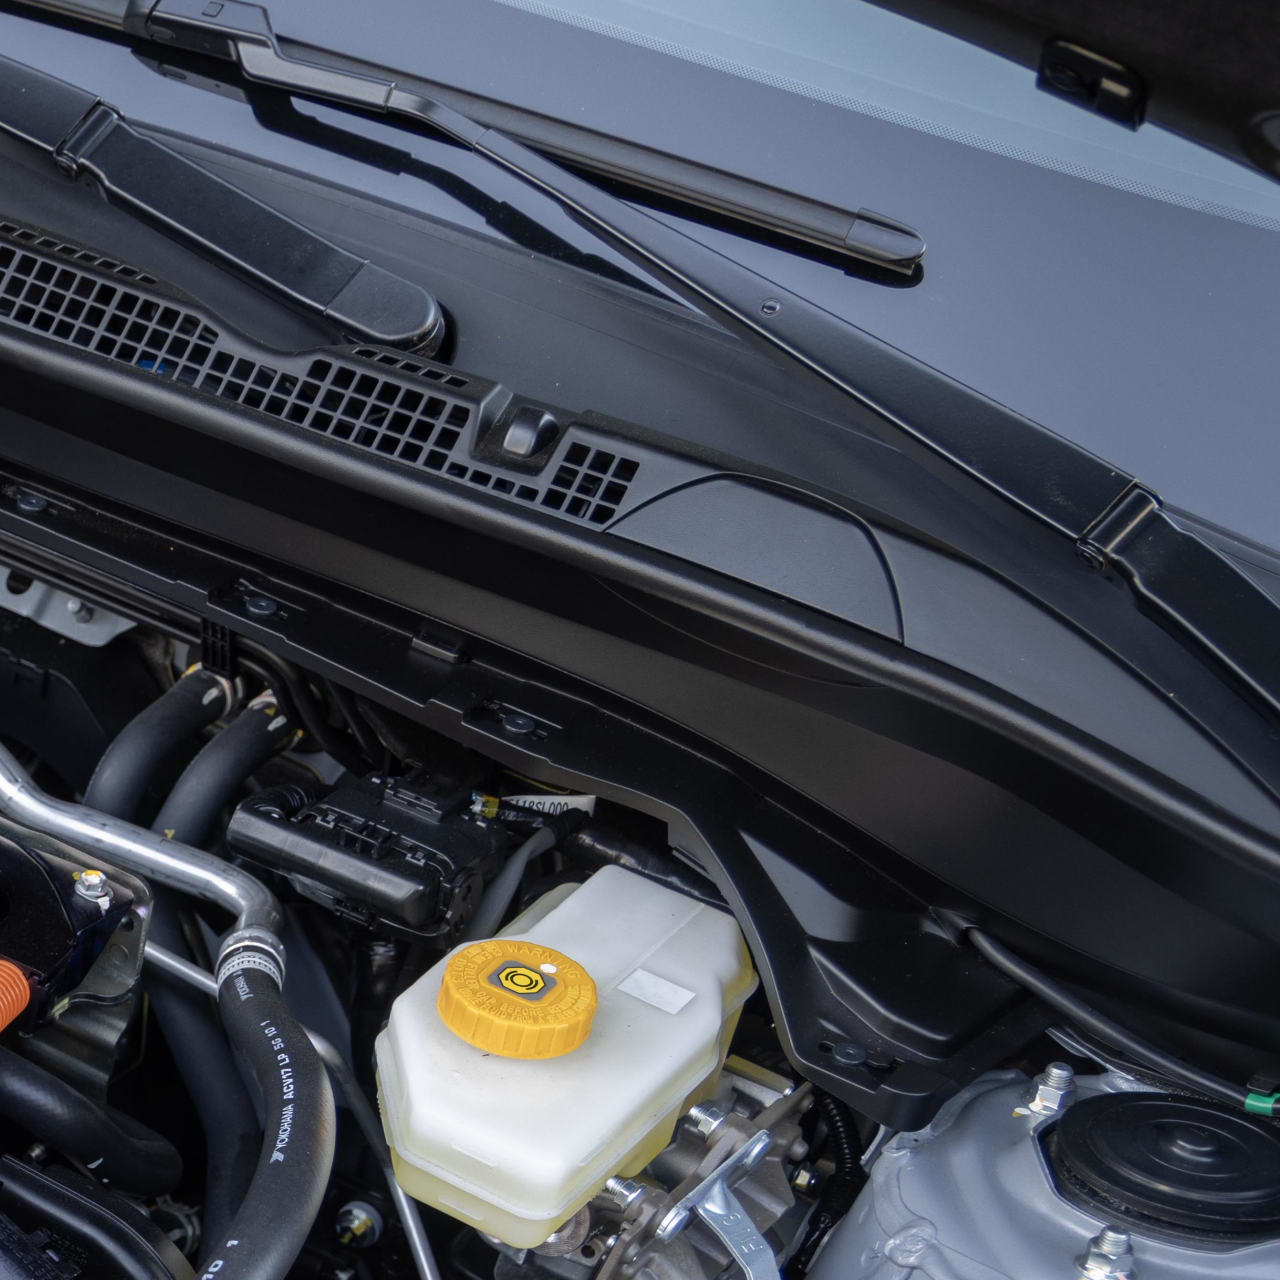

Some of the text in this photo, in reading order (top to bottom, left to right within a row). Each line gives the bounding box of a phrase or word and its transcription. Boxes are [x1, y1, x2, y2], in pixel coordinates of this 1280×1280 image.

[506, 943, 581, 978] WARNING
[265, 1026, 277, 1037] 10
[271, 1038, 284, 1051] 5G
[277, 1054, 289, 1066] LP
[281, 1068, 294, 1099] ACV17
[276, 1104, 294, 1151] YOKOHAMA
